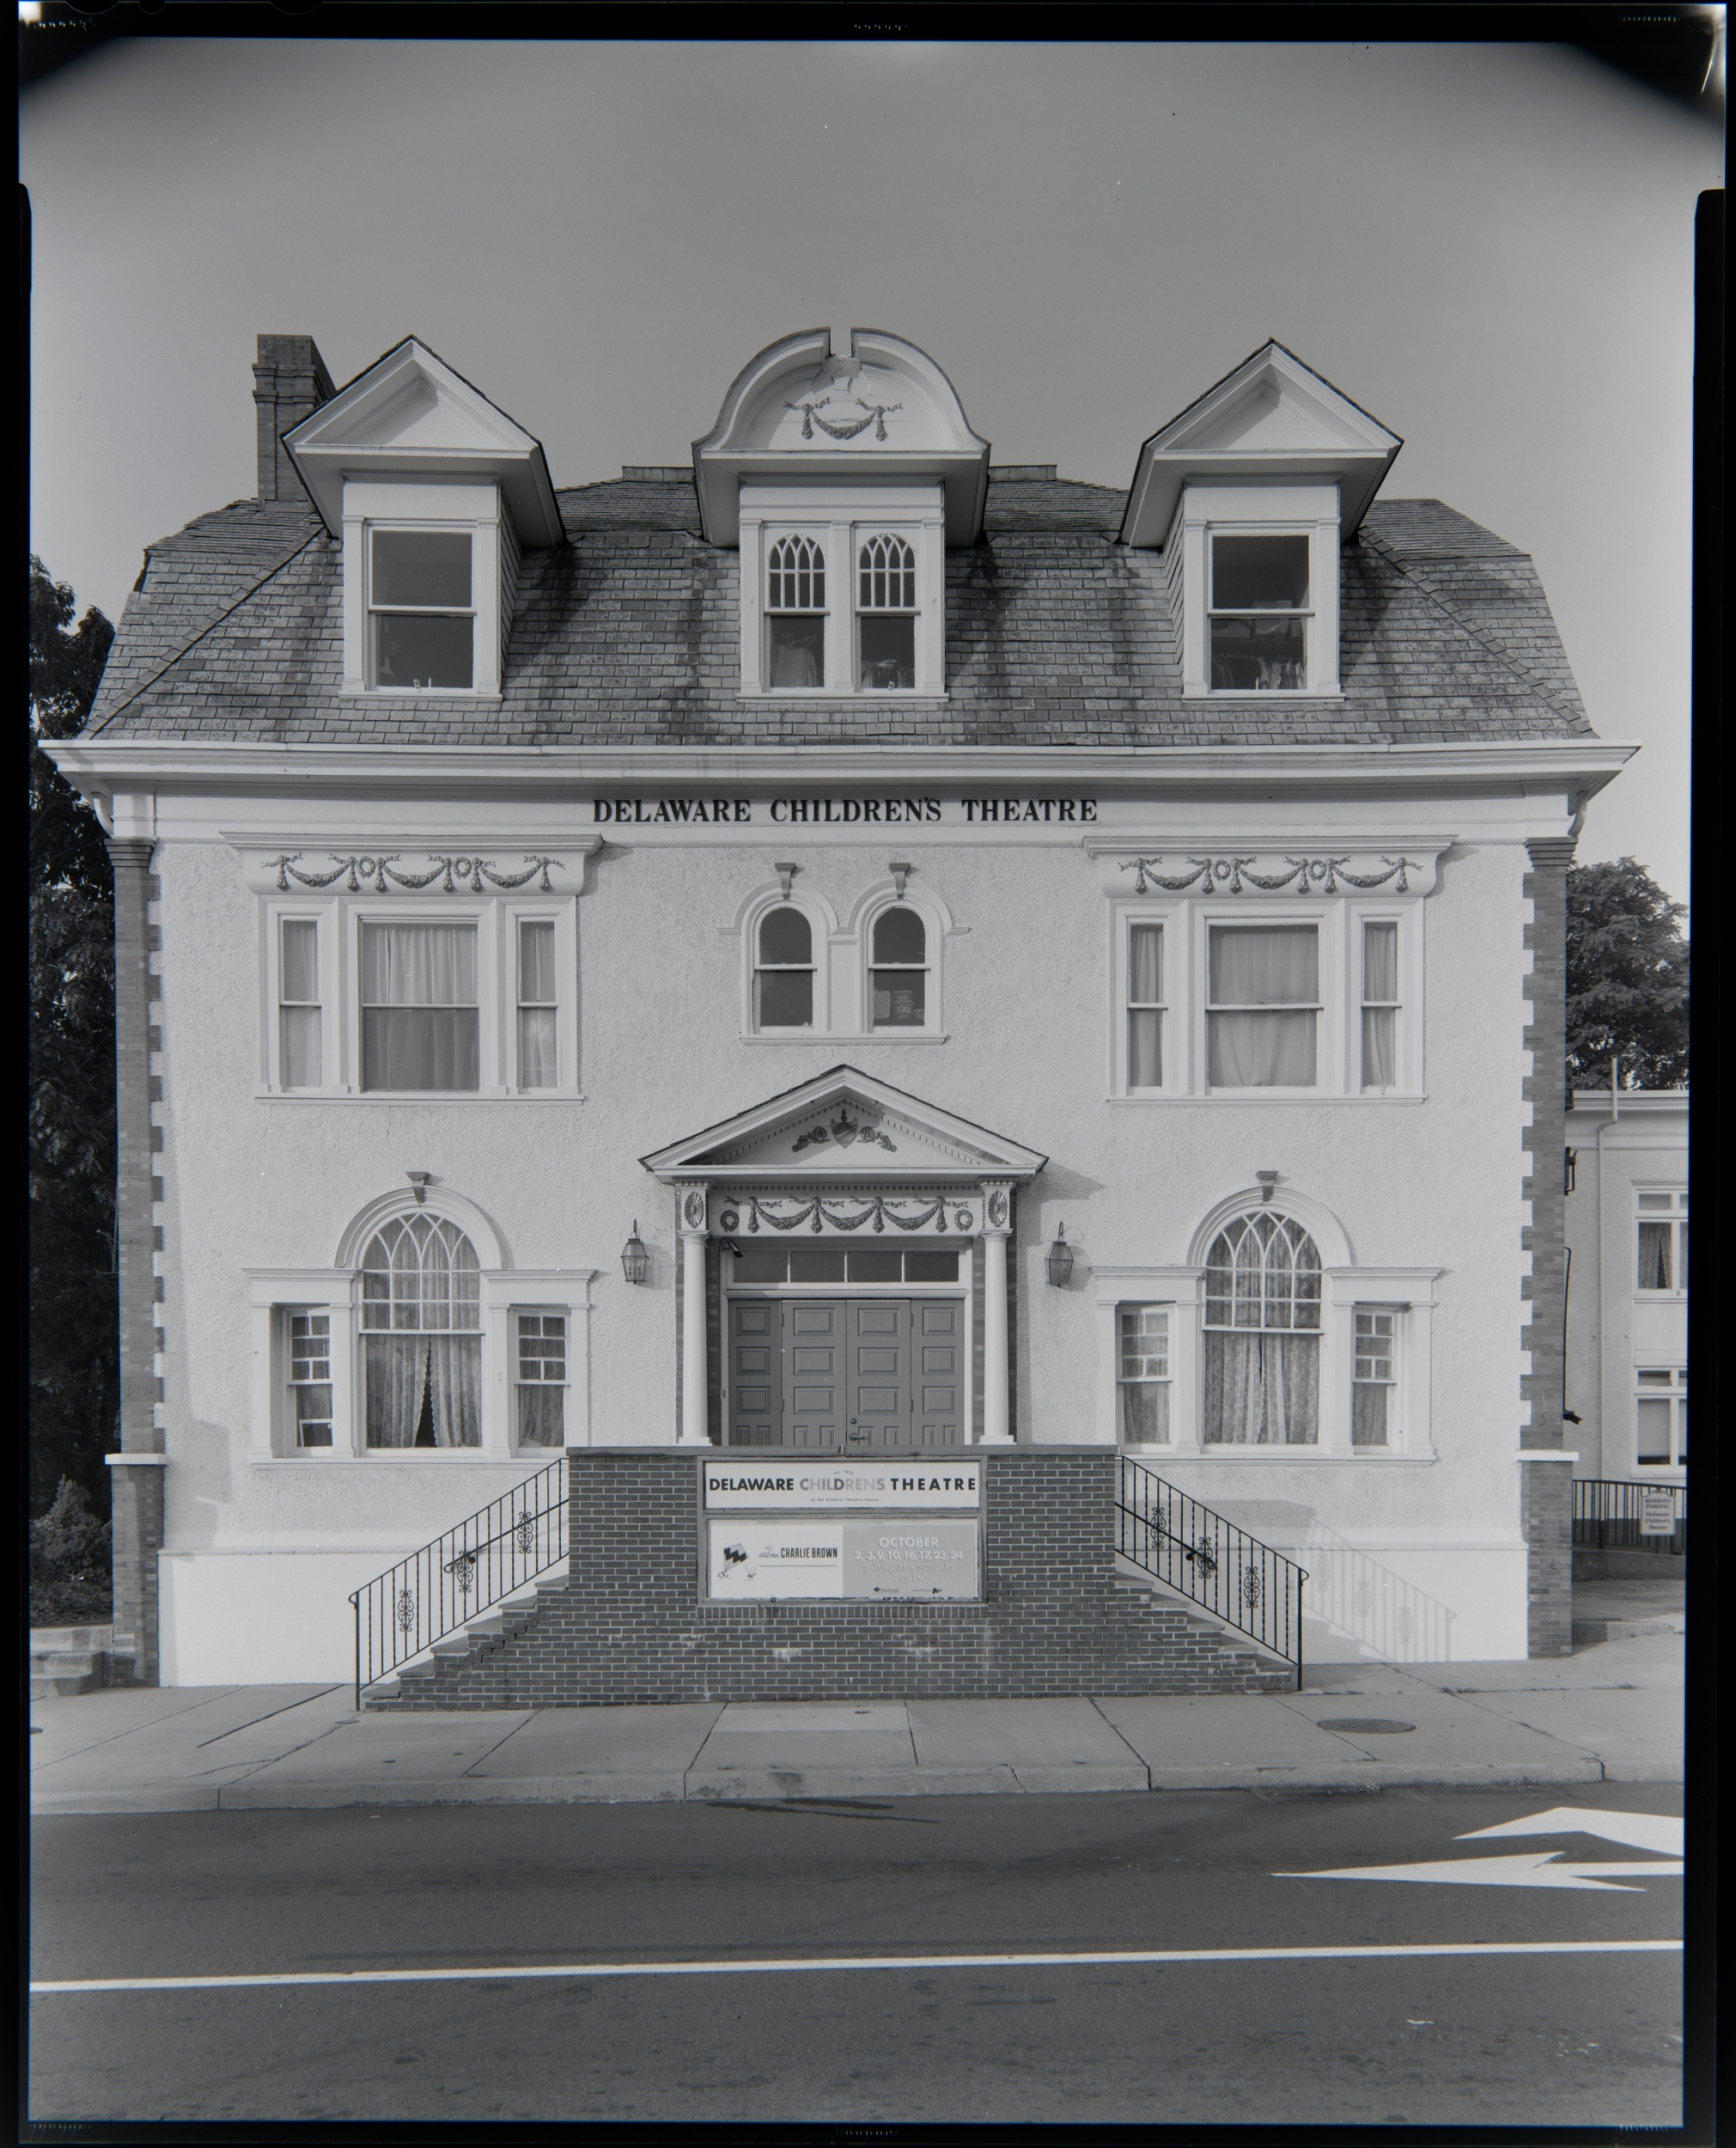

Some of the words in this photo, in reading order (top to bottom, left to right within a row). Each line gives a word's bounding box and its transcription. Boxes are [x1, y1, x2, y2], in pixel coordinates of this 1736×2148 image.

[592, 799, 752, 822] DELAWARE
[770, 796, 941, 822] CHILDREN'S
[961, 799, 1097, 822] THEATRE
[128, 1383, 155, 1397] 1892
[710, 1478, 794, 1491] DELAWARE
[891, 1478, 976, 1491] THEATRE
[878, 1536, 939, 1548] OCTOBER
[780, 1547, 810, 1559] CHARLIE
[812, 1547, 838, 1559] BROWN
[855, 1550, 864, 1561] 2,
[887, 1550, 902, 1561] 10,
[904, 1550, 918, 1561] 16,
[933, 1550, 948, 1561] 23,
[950, 1550, 963, 1560] 24
